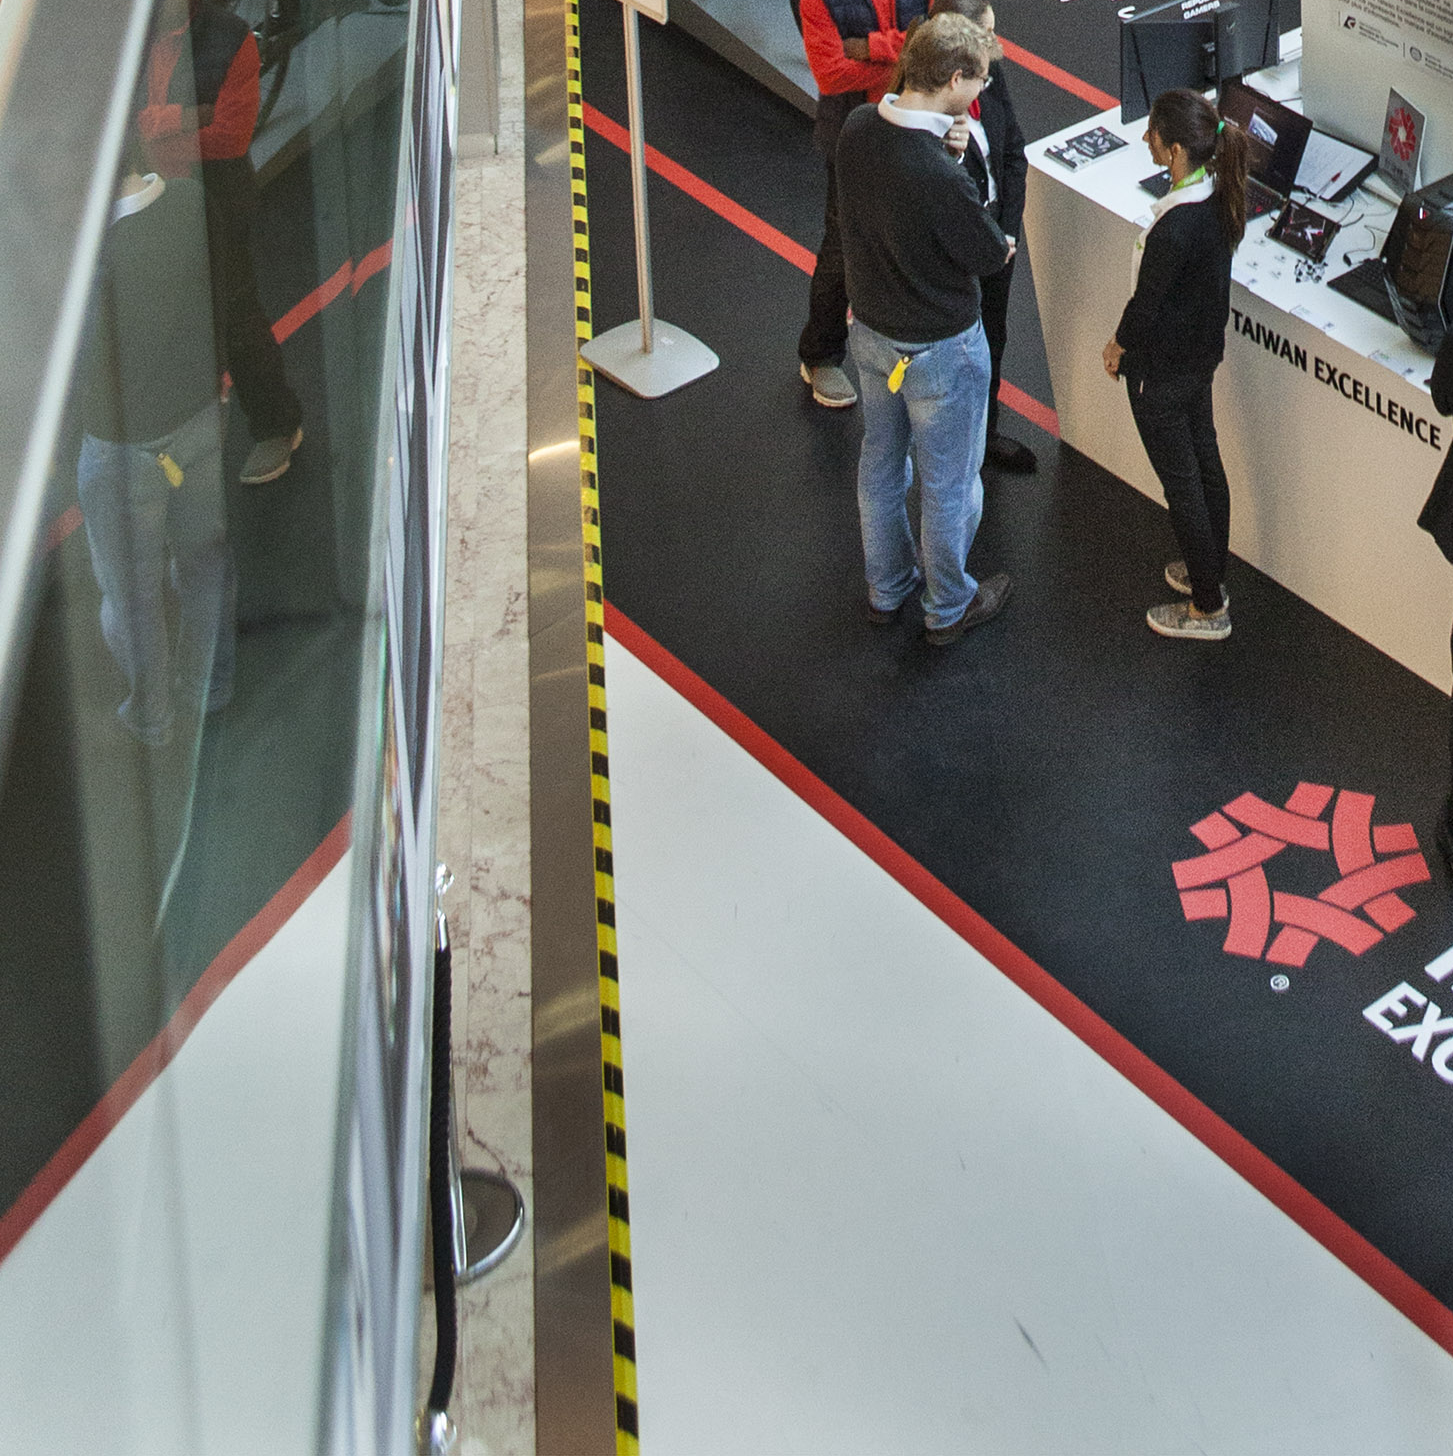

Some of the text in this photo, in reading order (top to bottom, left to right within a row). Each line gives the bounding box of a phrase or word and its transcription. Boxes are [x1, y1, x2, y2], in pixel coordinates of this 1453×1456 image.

[1182, 0, 1220, 20] GAMERS
[1231, 307, 1442, 451] TAIWAN EXCELLENCE
